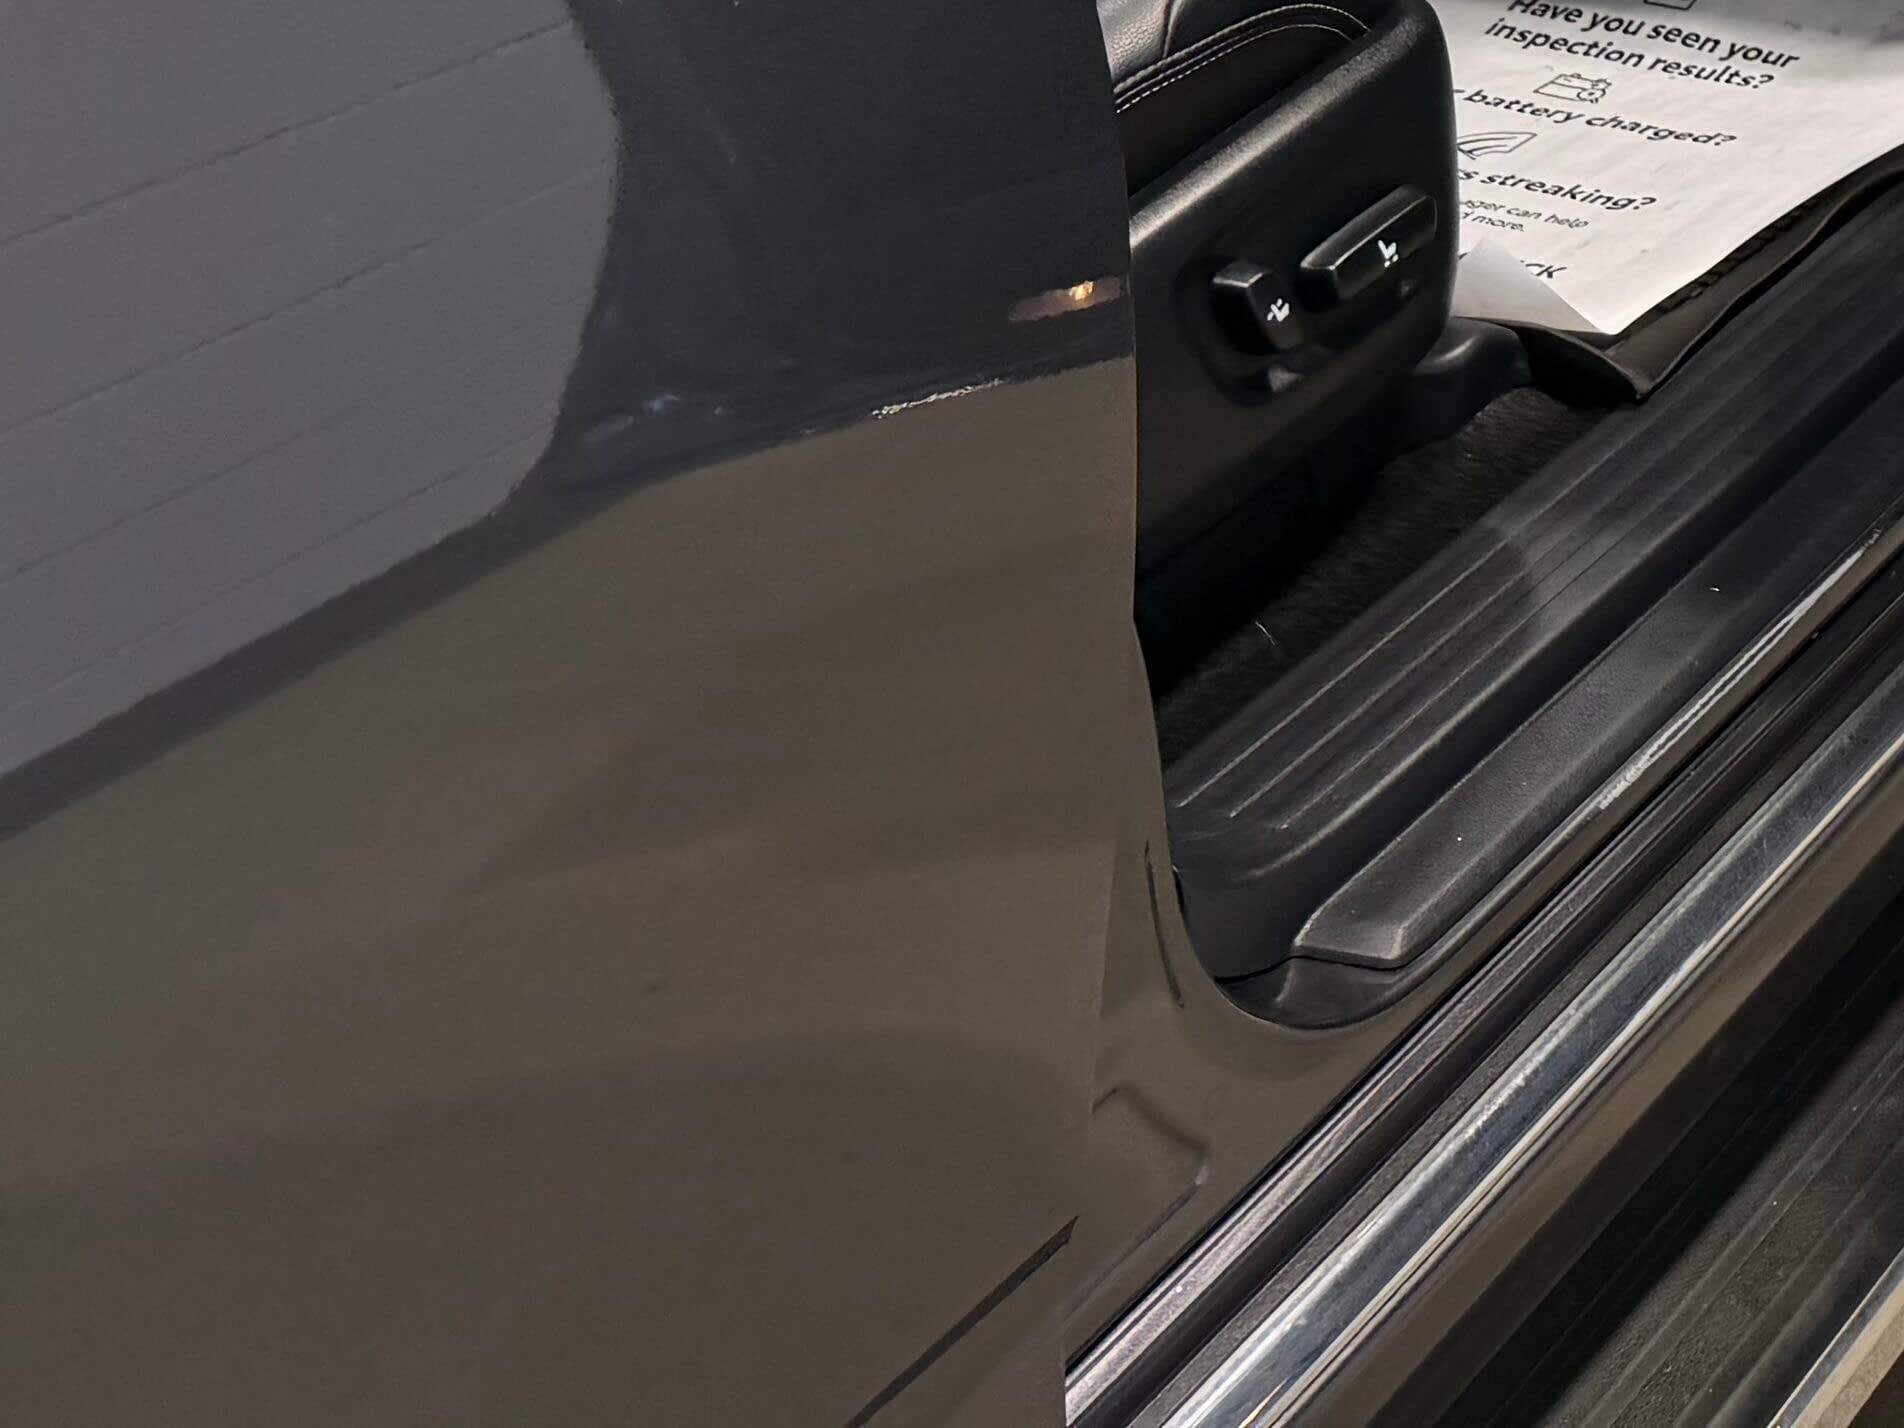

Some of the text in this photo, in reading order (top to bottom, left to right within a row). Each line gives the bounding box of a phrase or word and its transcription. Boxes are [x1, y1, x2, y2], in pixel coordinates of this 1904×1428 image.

[1485, 18, 1775, 89] inspection results?
[1580, 12, 1646, 36] you
[1647, 24, 1720, 53] seen
[1719, 42, 1801, 68] your
[1463, 89, 1738, 146] battery charged?
[1480, 171, 1657, 211] streaking?
[1507, 206, 1542, 219] can
[1545, 213, 1589, 229] help
